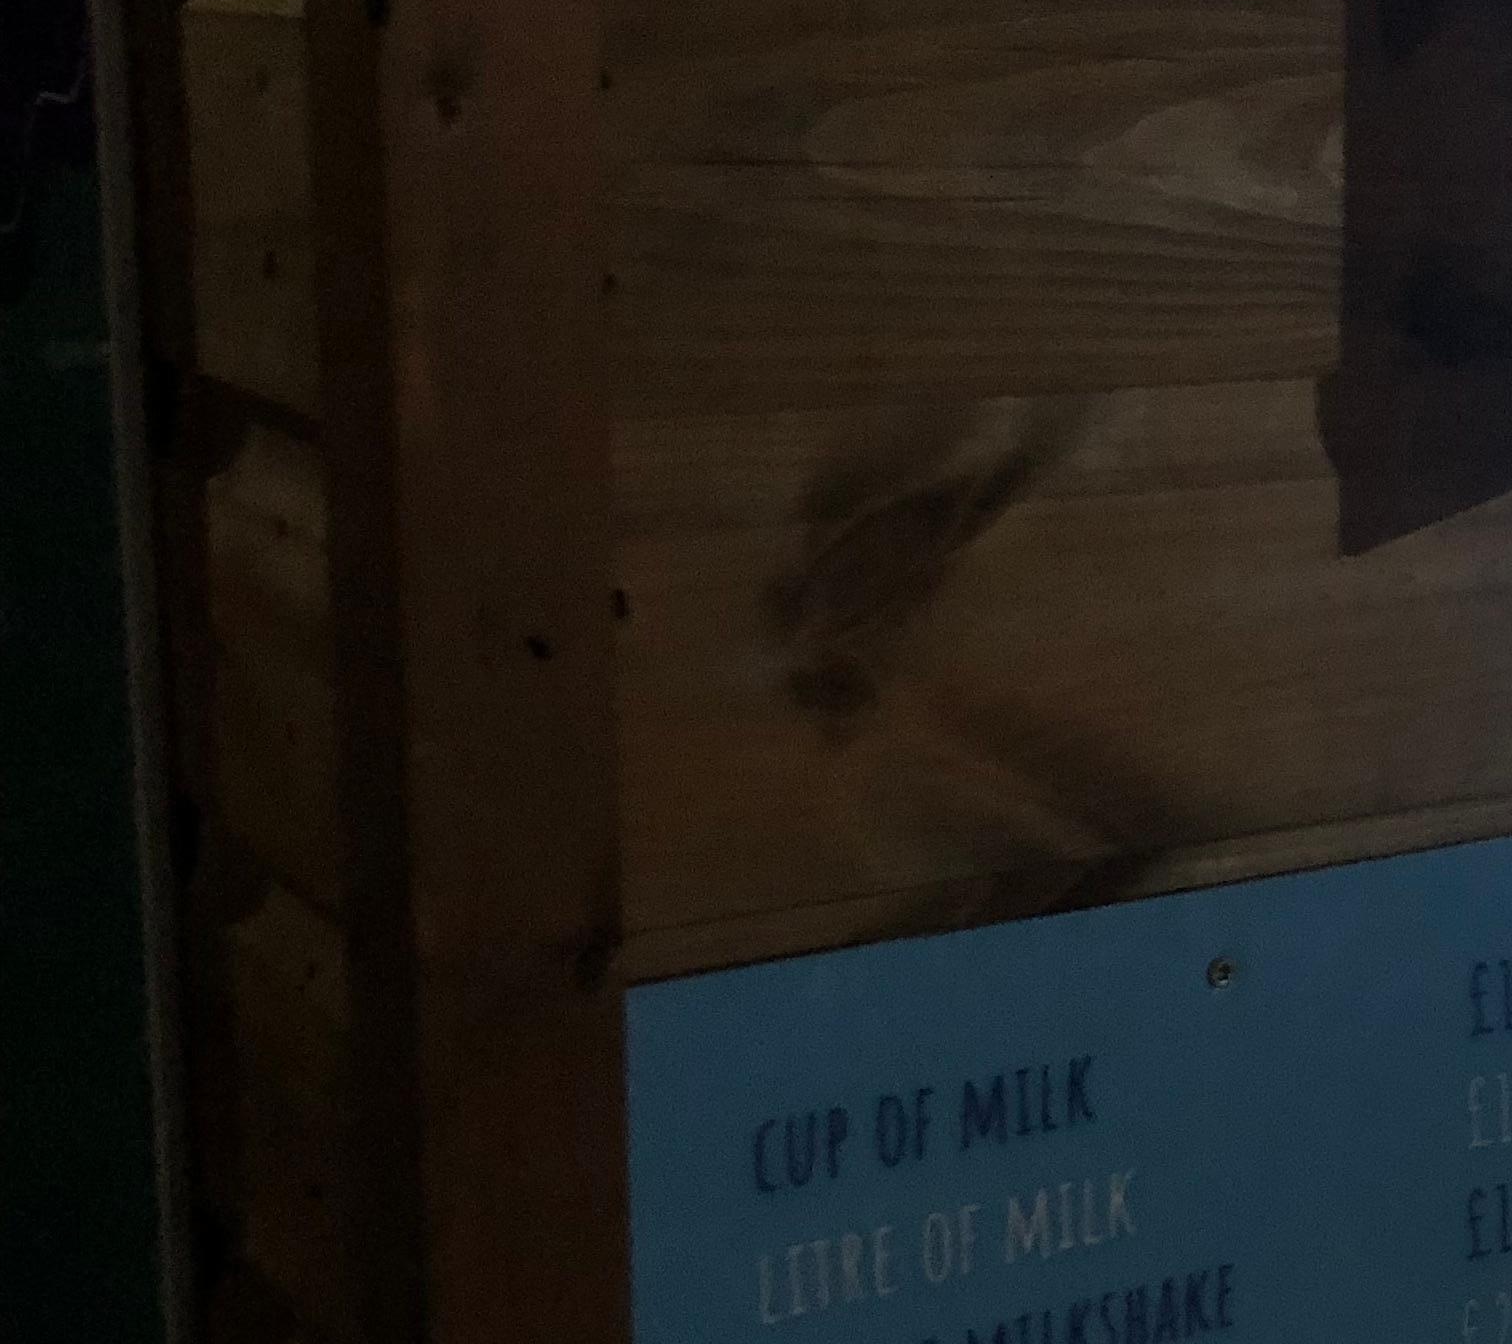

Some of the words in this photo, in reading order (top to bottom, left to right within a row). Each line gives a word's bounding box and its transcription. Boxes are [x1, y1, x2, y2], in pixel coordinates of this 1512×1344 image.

[752, 1106, 849, 1193] CUP
[875, 1088, 933, 1168] OF
[961, 1055, 1097, 1152] MILK
[758, 1224, 895, 1325] LITRE
[920, 1205, 980, 1283] OF
[1003, 1169, 1137, 1264] MILK
